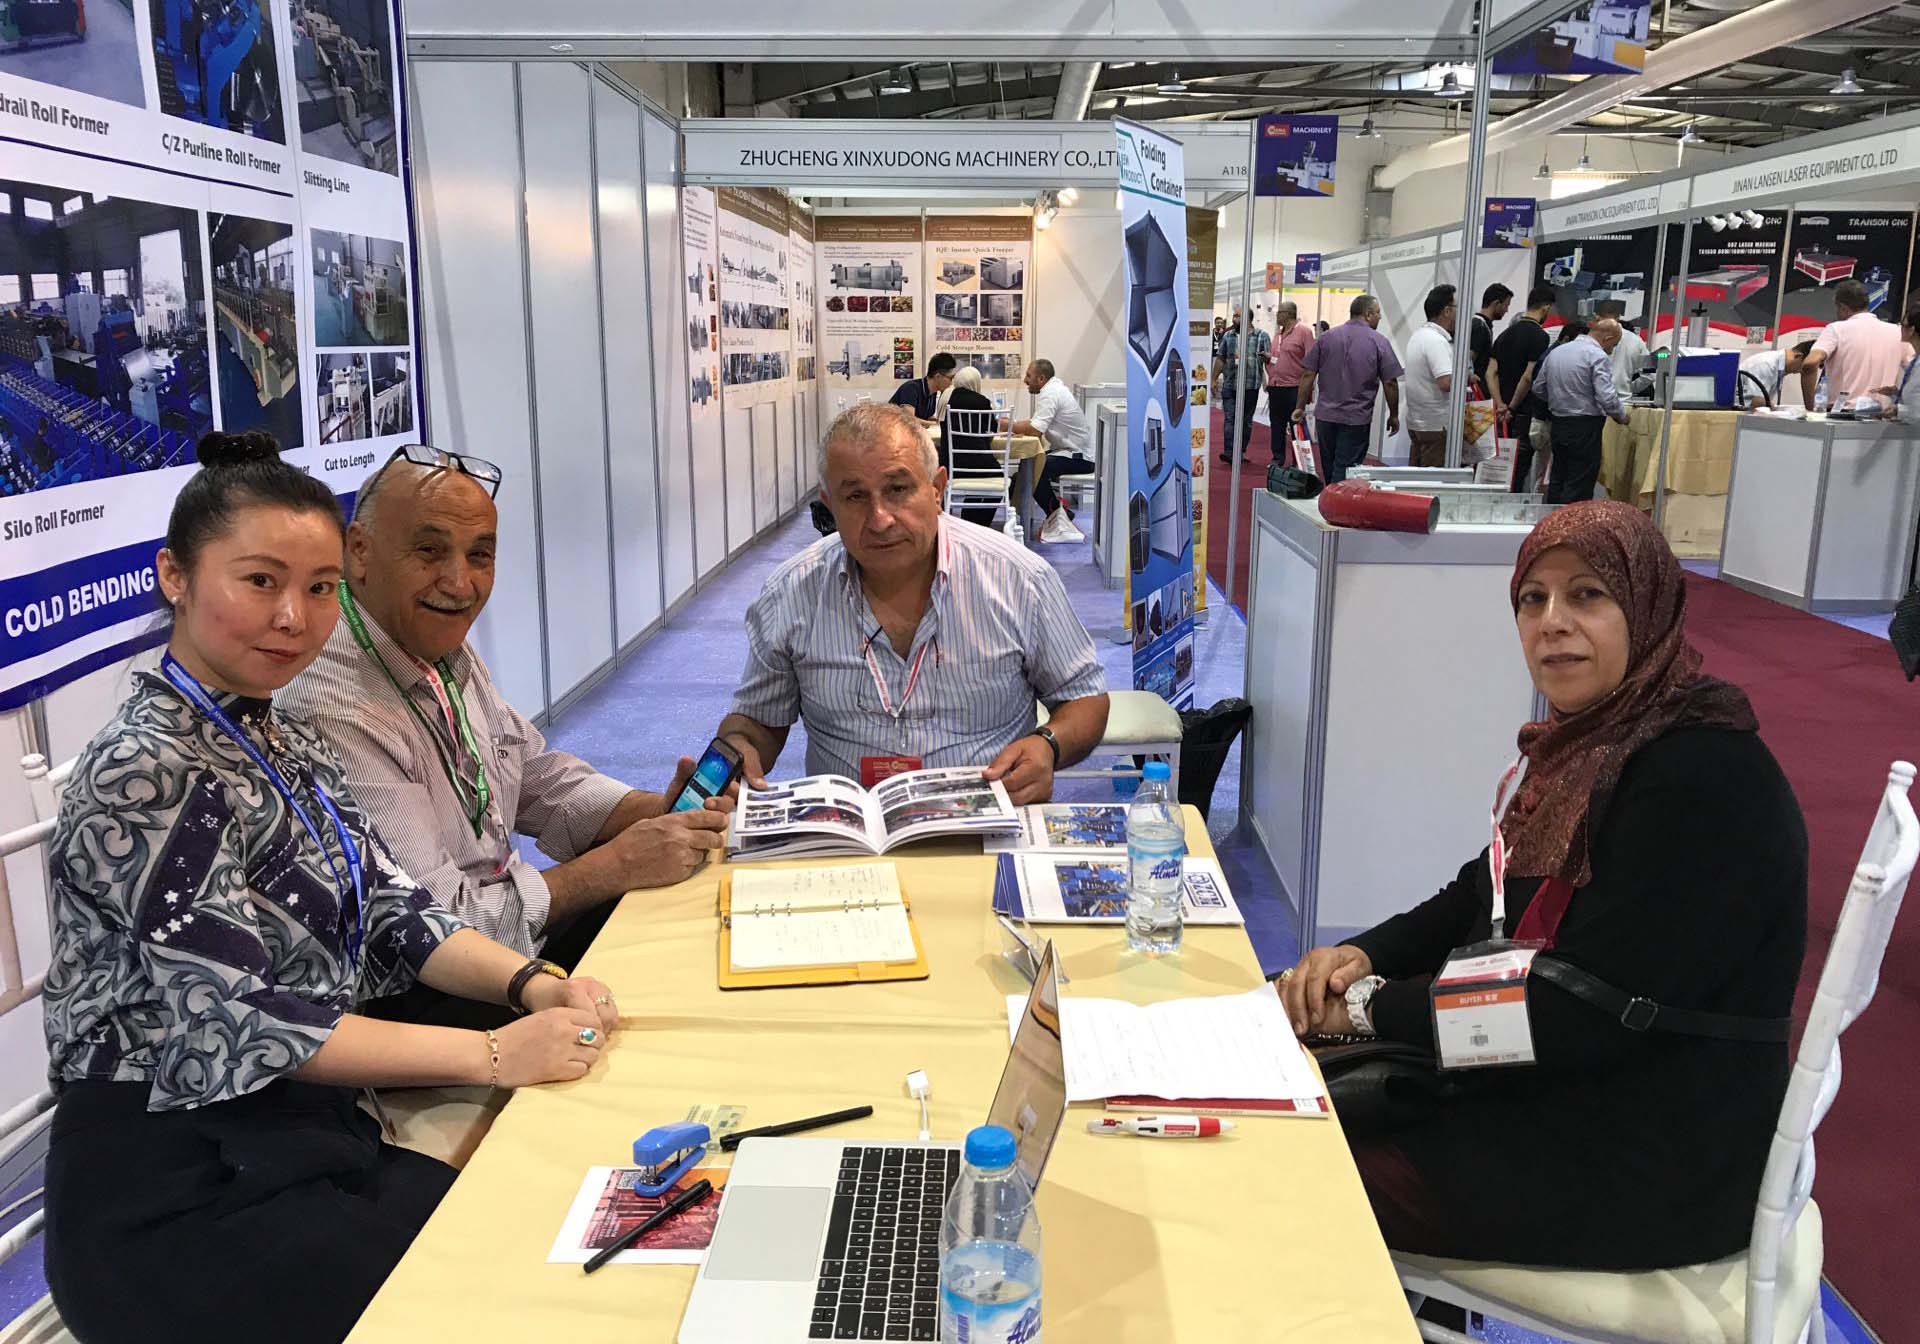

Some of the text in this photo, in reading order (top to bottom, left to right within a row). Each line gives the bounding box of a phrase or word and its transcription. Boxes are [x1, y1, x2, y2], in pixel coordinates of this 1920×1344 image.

[31, 100, 58, 124] Roll
[61, 108, 109, 135] Former
[162, 132, 281, 174] C/Z Purline Roll Former
[740, 150, 838, 167] ZHUCHENG
[843, 150, 951, 167] XINXUDONG
[956, 151, 1059, 168] MACHINERY
[1140, 139, 1166, 170] Folding
[303, 170, 350, 193] Slitting Line
[1150, 172, 1183, 198] Container
[1222, 166, 1247, 176] A118
[1731, 178, 1752, 194] JINAN
[1753, 171, 1783, 189] LANSEN
[1783, 165, 1809, 184] LASER
[1810, 155, 1860, 178] EQUIPMENT
[1879, 149, 1898, 167] LTD
[1849, 218, 1908, 226] TRANSON CNC
[325, 451, 375, 471] Cut to Length
[4, 503, 105, 541] Silo Roll Former
[5, 566, 155, 638] COLD BENDING
